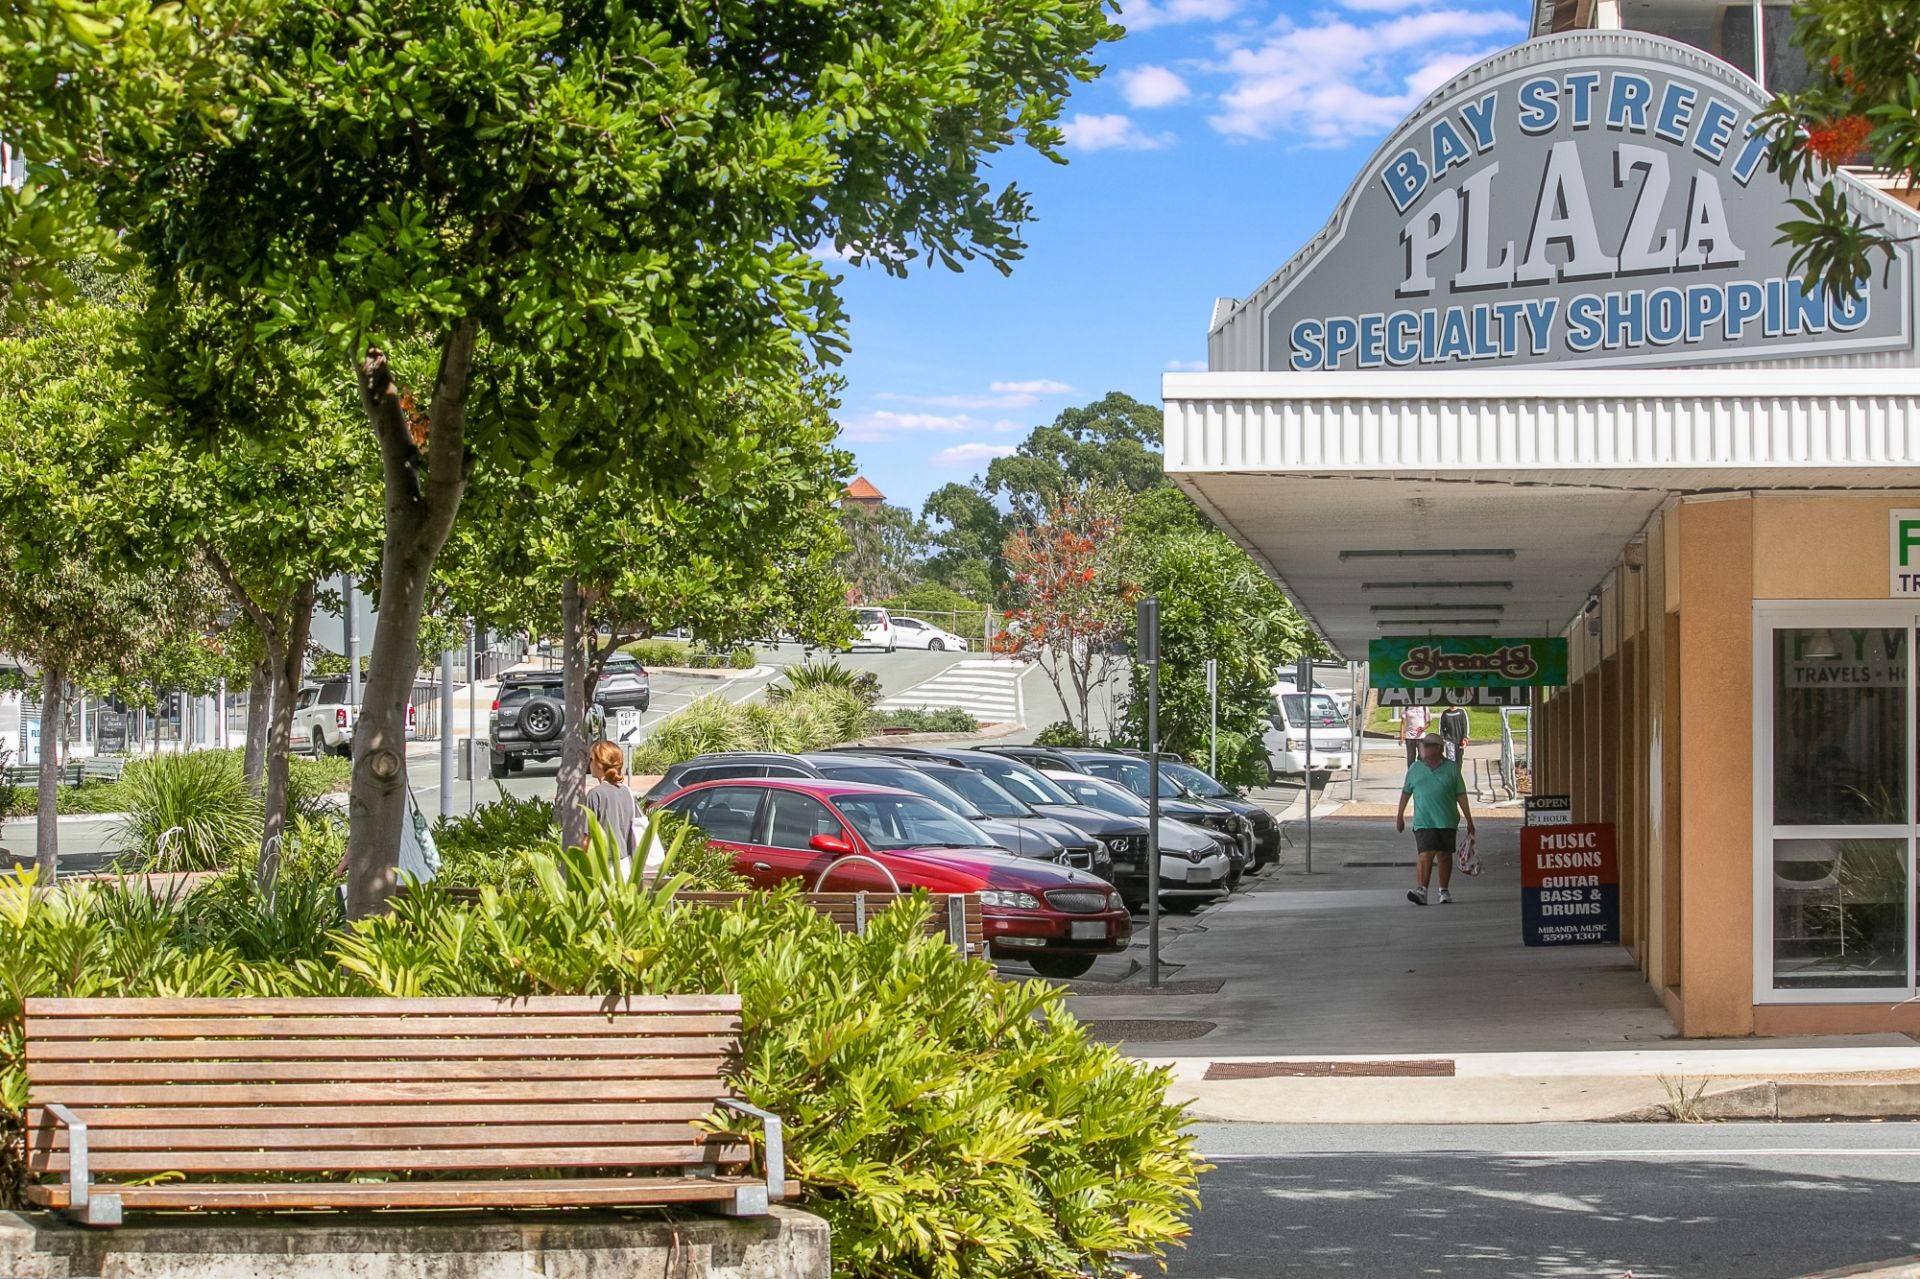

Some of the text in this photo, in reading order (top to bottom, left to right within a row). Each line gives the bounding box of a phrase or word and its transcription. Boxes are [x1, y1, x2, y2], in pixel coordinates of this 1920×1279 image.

[1381, 71, 1772, 214] BAY STREET
[1396, 140, 1746, 297] PLAZA
[1290, 275, 1871, 372] SPECIALTY SHOPPING
[1794, 666, 1870, 682] TRAVELS
[1536, 798, 1568, 808] OPEN
[1540, 832, 1597, 850] MUSIC
[1536, 851, 1602, 869] LESSONS
[1542, 875, 1599, 888] GUITAR
[1540, 888, 1602, 902] BASS &
[1541, 903, 1601, 916] DRUMS
[1538, 923, 1607, 934] MIRANDA MUSIC
[1542, 932, 1601, 942] 5599 1301
